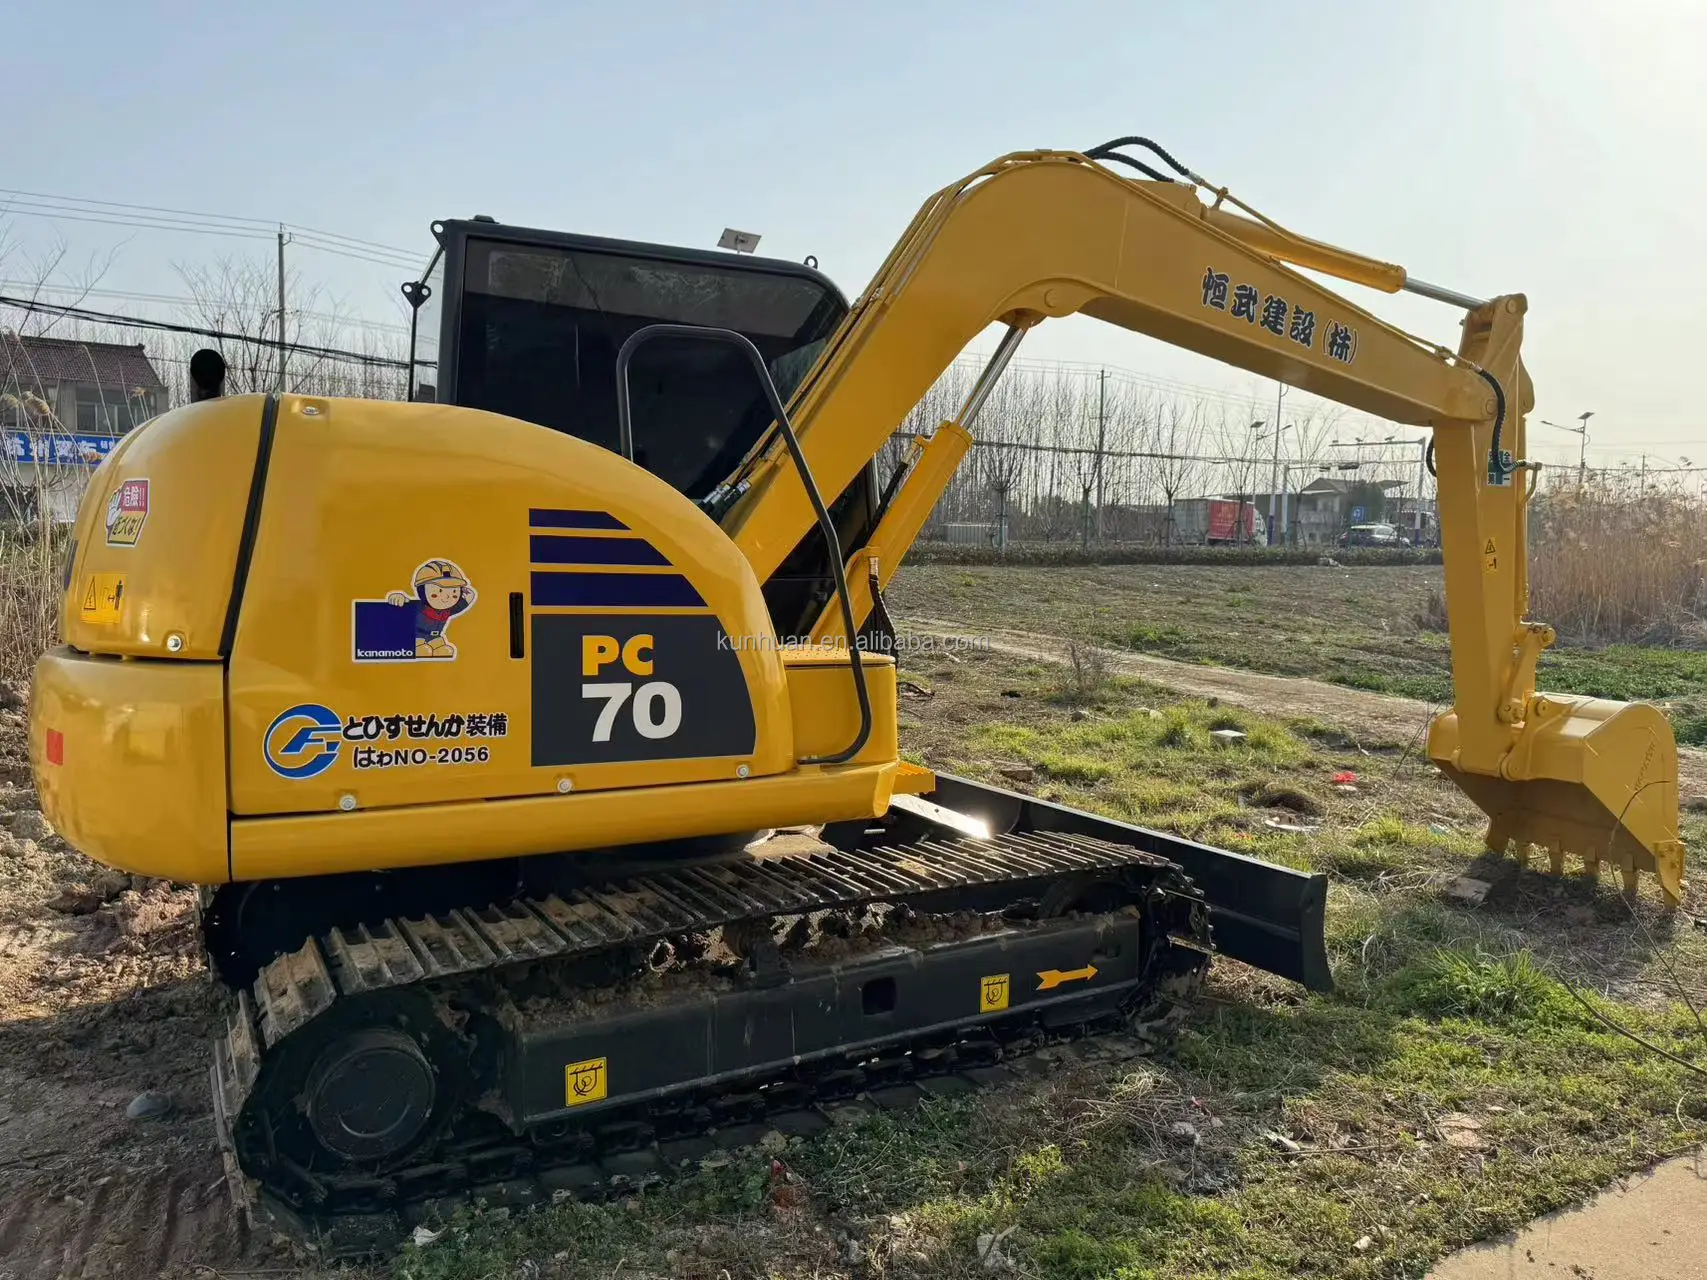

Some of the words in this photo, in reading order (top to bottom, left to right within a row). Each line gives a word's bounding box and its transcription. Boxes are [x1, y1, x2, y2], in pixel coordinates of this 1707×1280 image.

[357, 648, 414, 657] kanamoto
[582, 634, 654, 676] PC
[581, 682, 682, 743] 70
